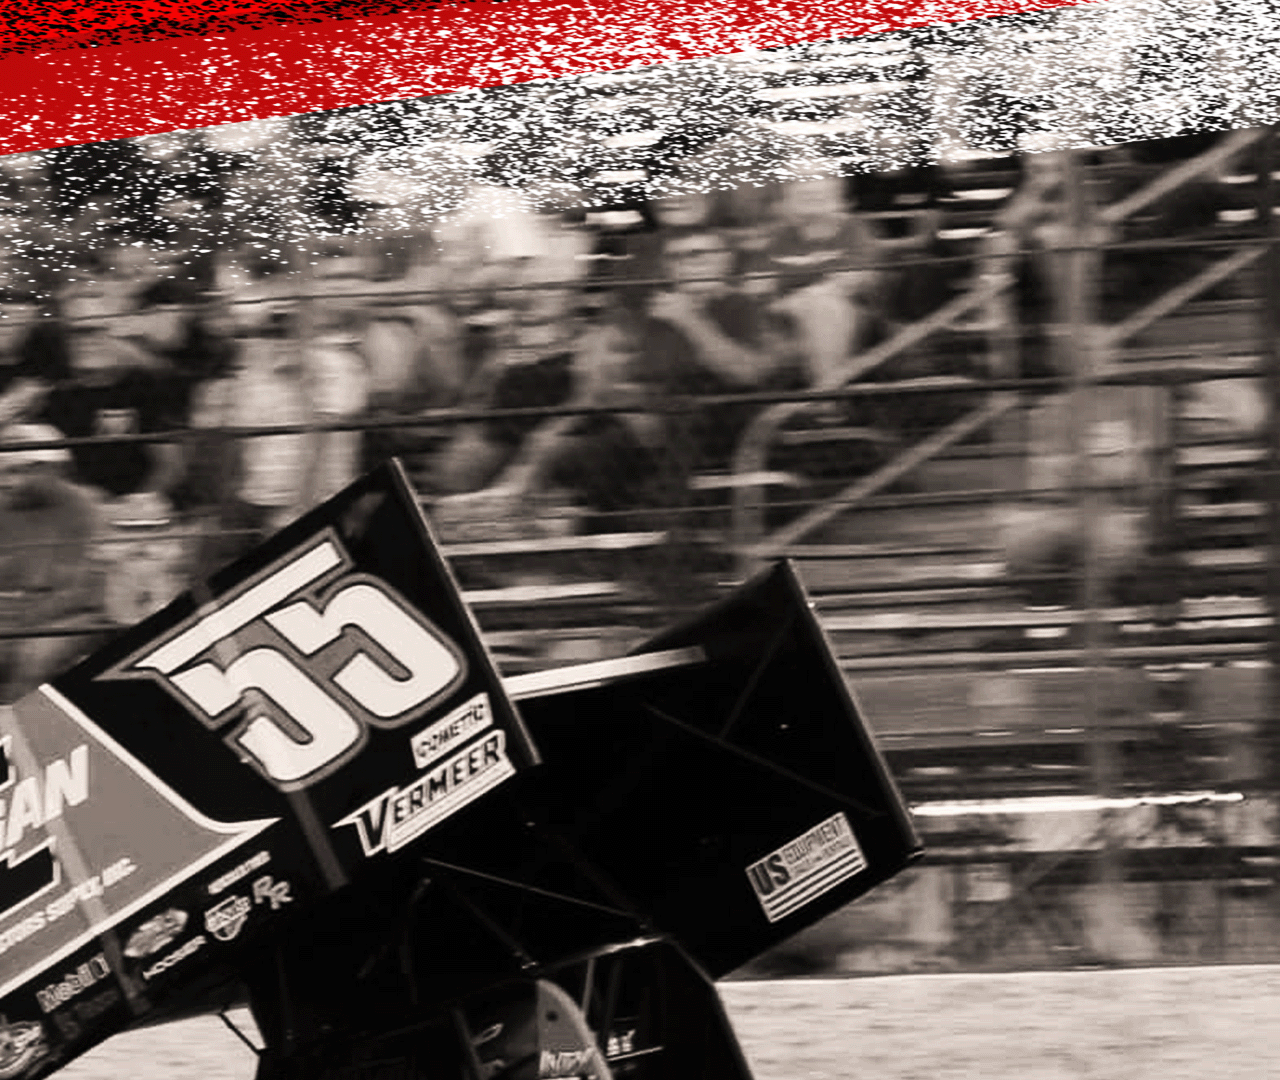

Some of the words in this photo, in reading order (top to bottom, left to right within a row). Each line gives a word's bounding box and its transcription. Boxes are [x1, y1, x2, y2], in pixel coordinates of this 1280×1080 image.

[122, 532, 462, 788] 55
[357, 738, 502, 852] VERMEER
[750, 852, 791, 896] US
